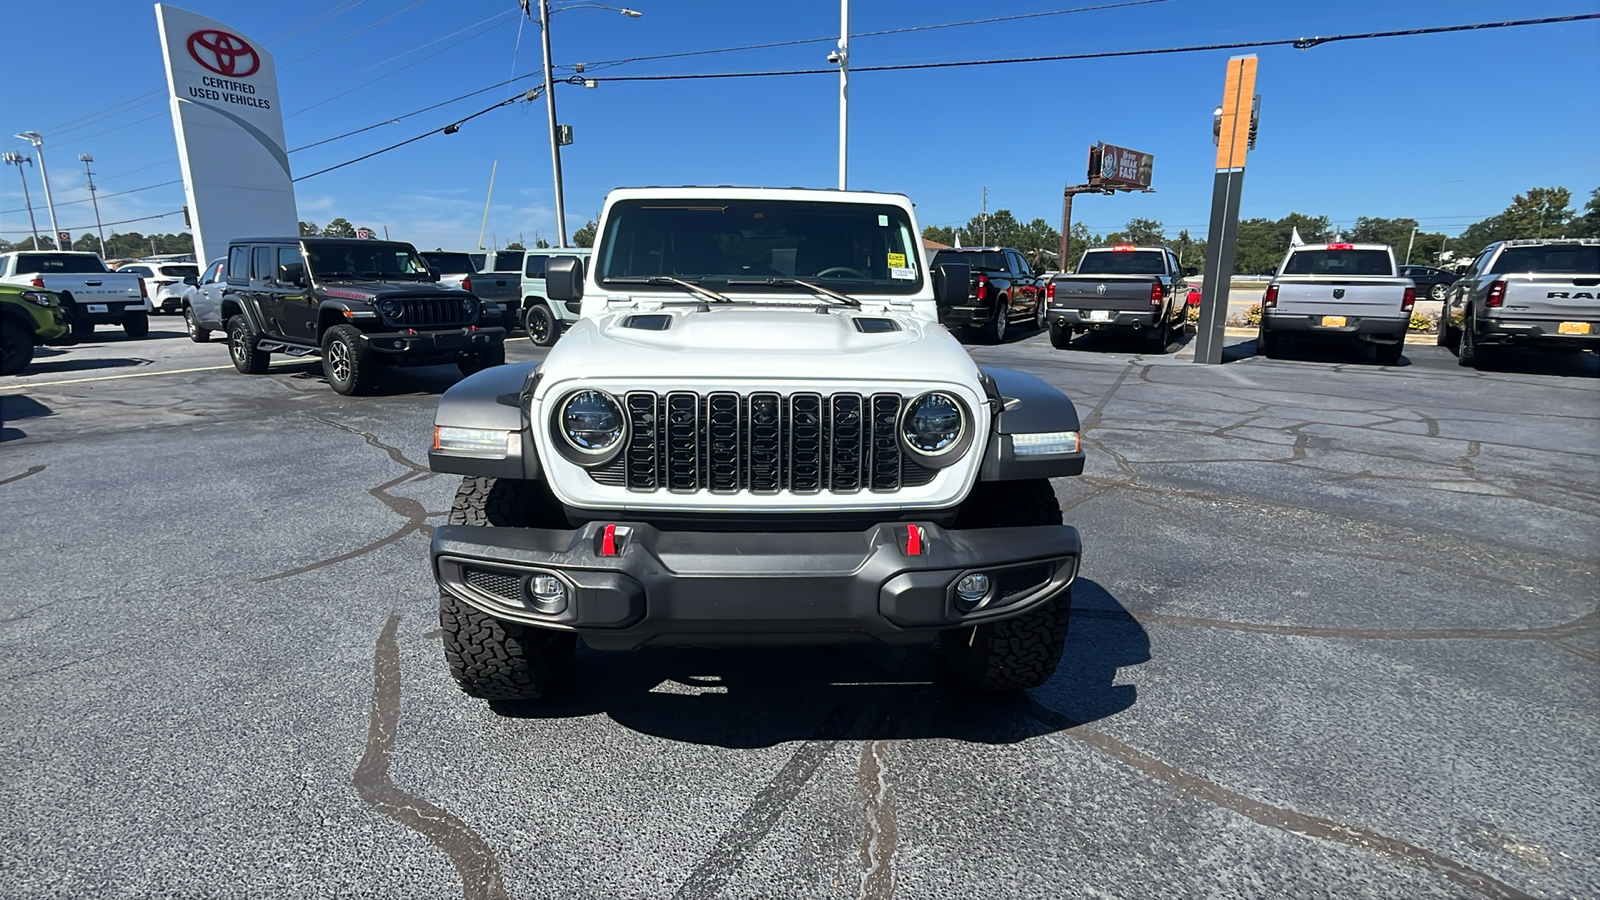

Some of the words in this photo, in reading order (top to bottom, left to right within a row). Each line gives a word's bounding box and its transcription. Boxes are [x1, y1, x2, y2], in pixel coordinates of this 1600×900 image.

[202, 76, 255, 95] CERTIFIED
[189, 86, 219, 101] USED
[221, 92, 271, 110] VEHICLES
[1119, 167, 1137, 180] FAST
[1546, 291, 1600, 300] RA
